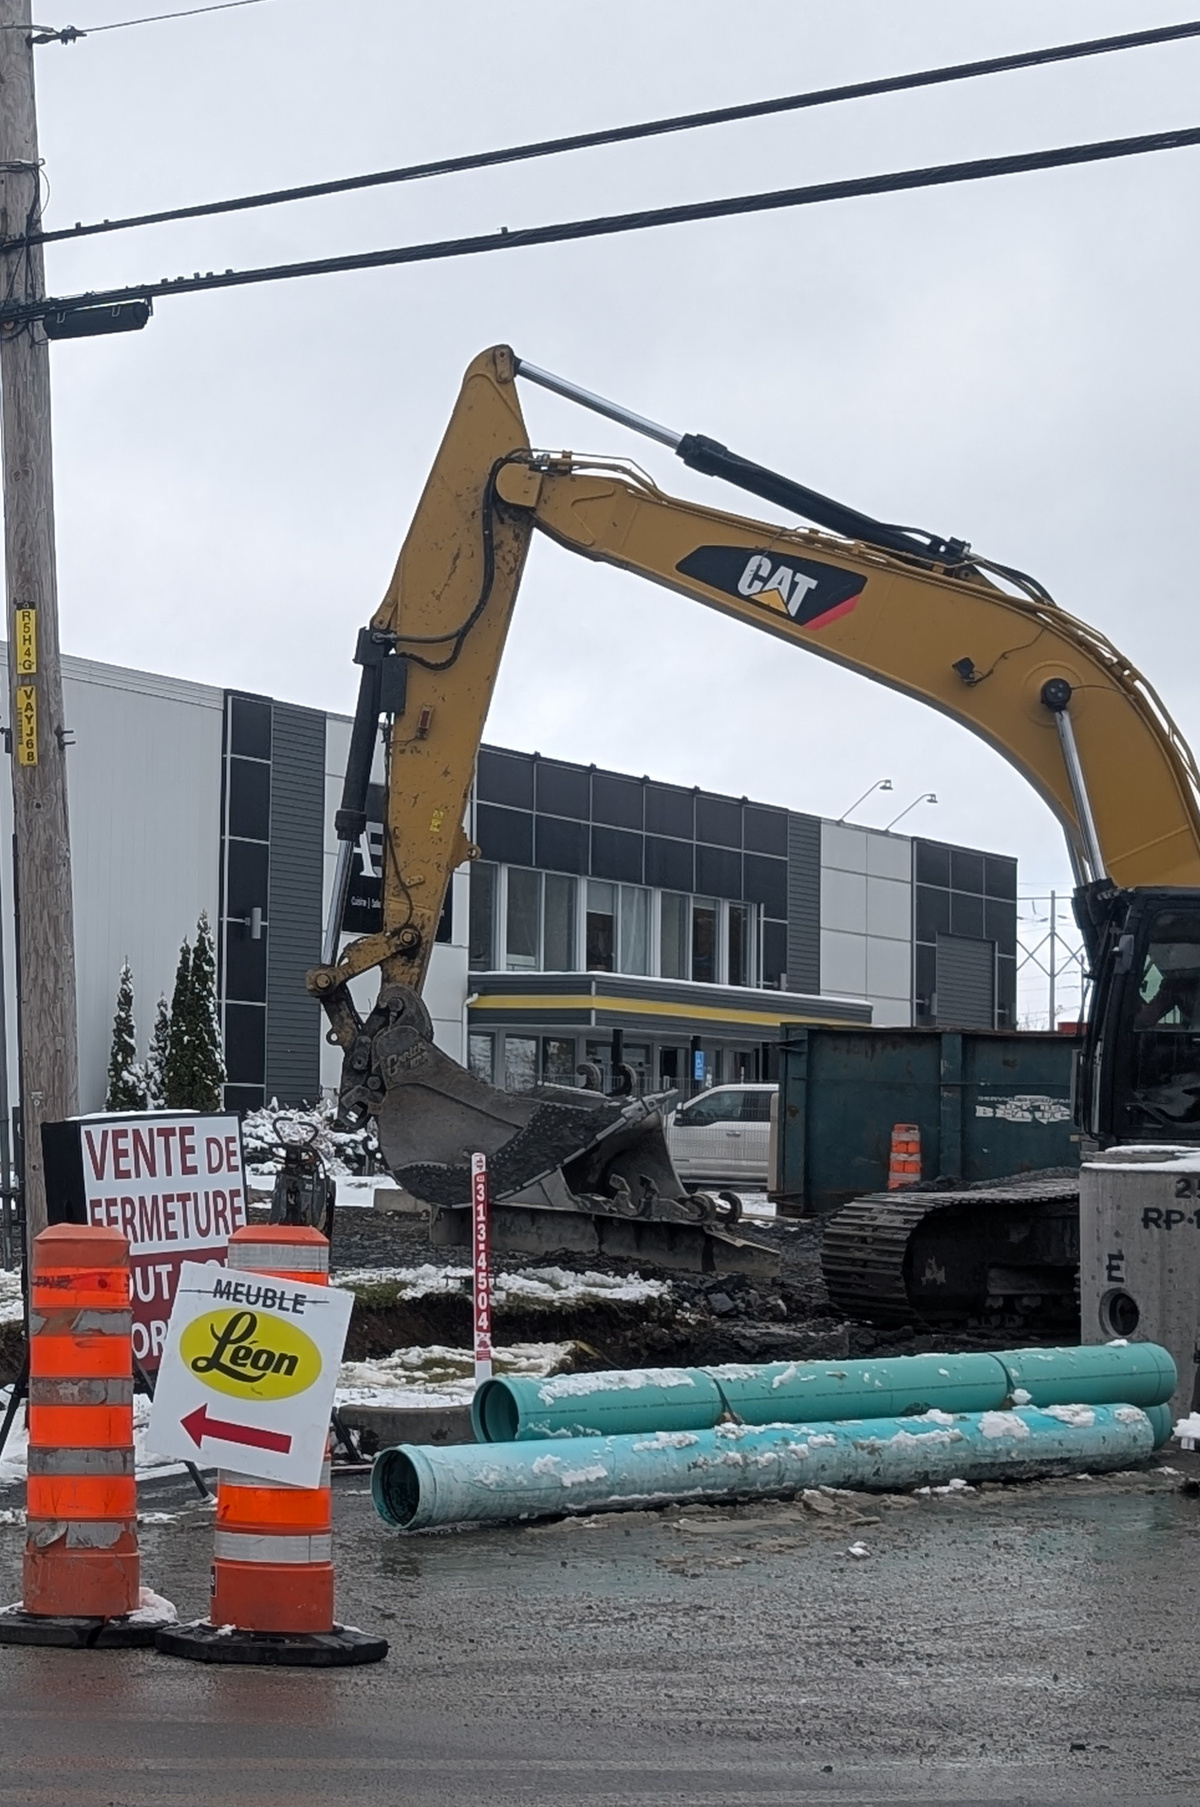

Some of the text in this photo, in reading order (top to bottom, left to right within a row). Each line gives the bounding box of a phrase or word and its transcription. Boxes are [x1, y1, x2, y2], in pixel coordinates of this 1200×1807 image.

[737, 555, 818, 617] CAT
[84, 1126, 240, 1181] VENTE DE
[212, 1278, 307, 1315] MEUBLE
[191, 1311, 299, 1383] Léon
